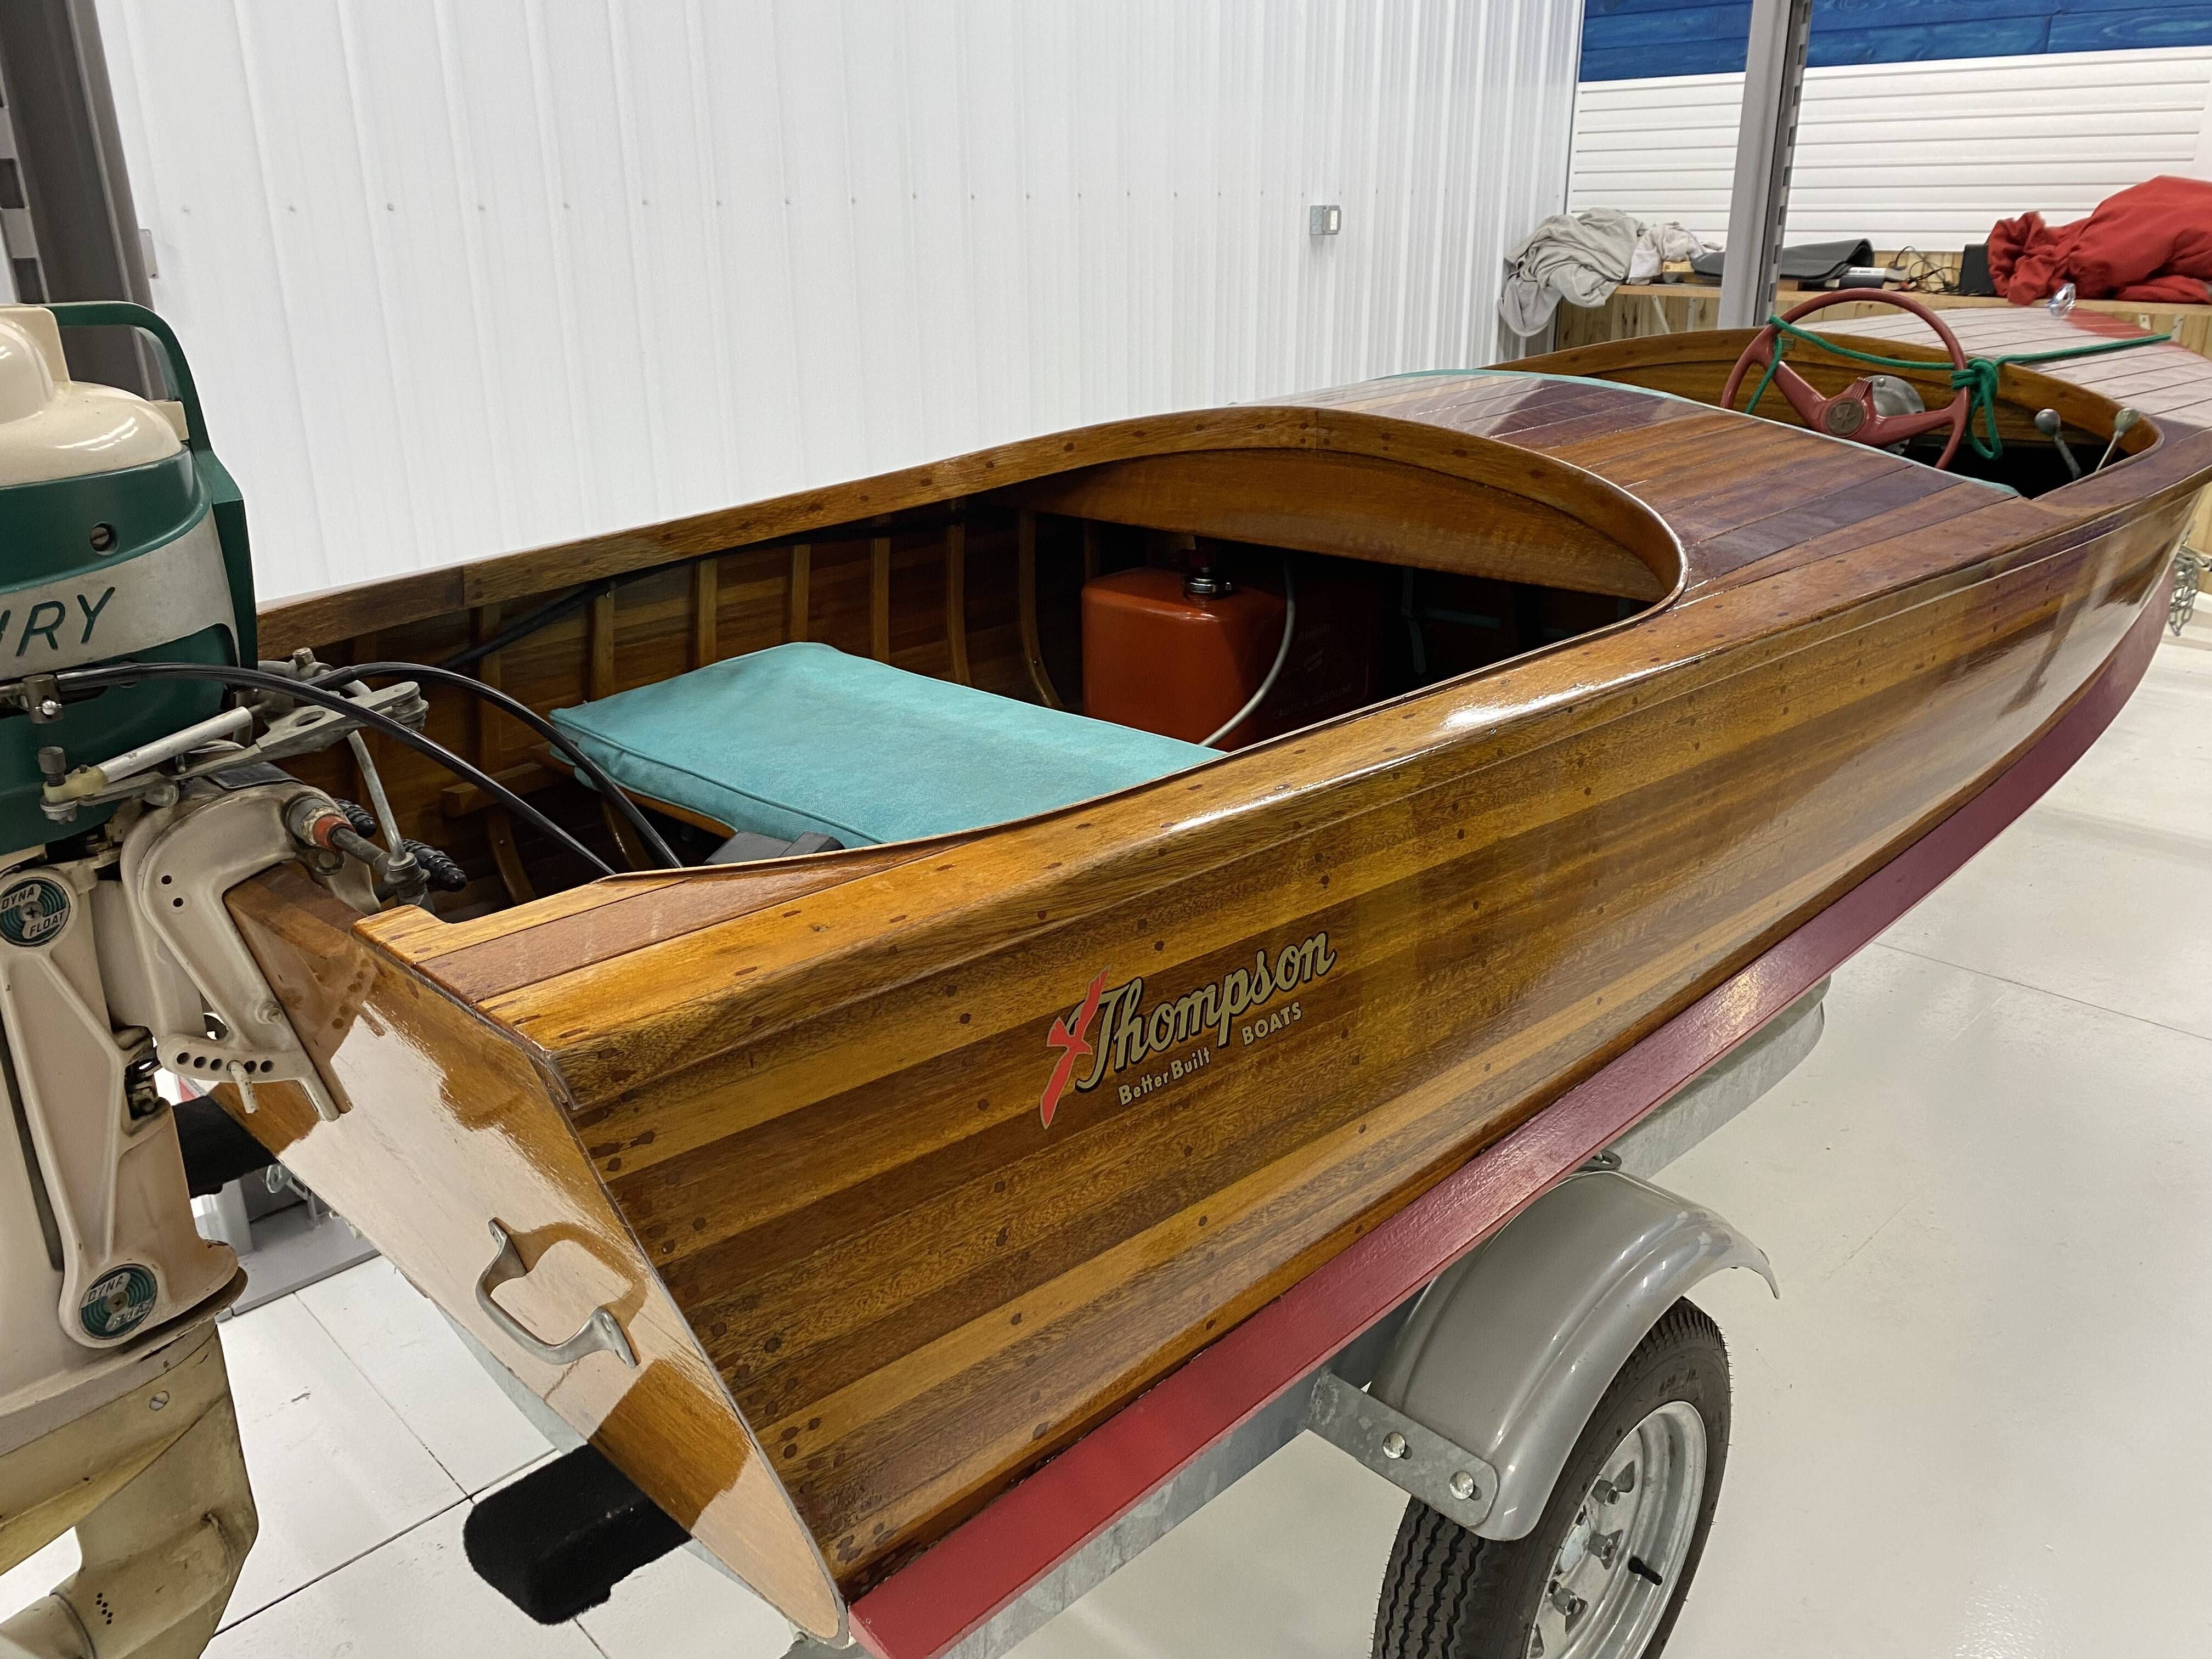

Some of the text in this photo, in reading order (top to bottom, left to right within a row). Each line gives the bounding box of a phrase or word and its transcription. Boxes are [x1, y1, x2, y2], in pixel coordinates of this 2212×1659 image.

[1, 886, 35, 910] DYNA
[30, 911, 65, 937] FLOAT
[1066, 931, 1337, 1091] Thompson
[1118, 1002, 1302, 1106] Better Built BOATS
